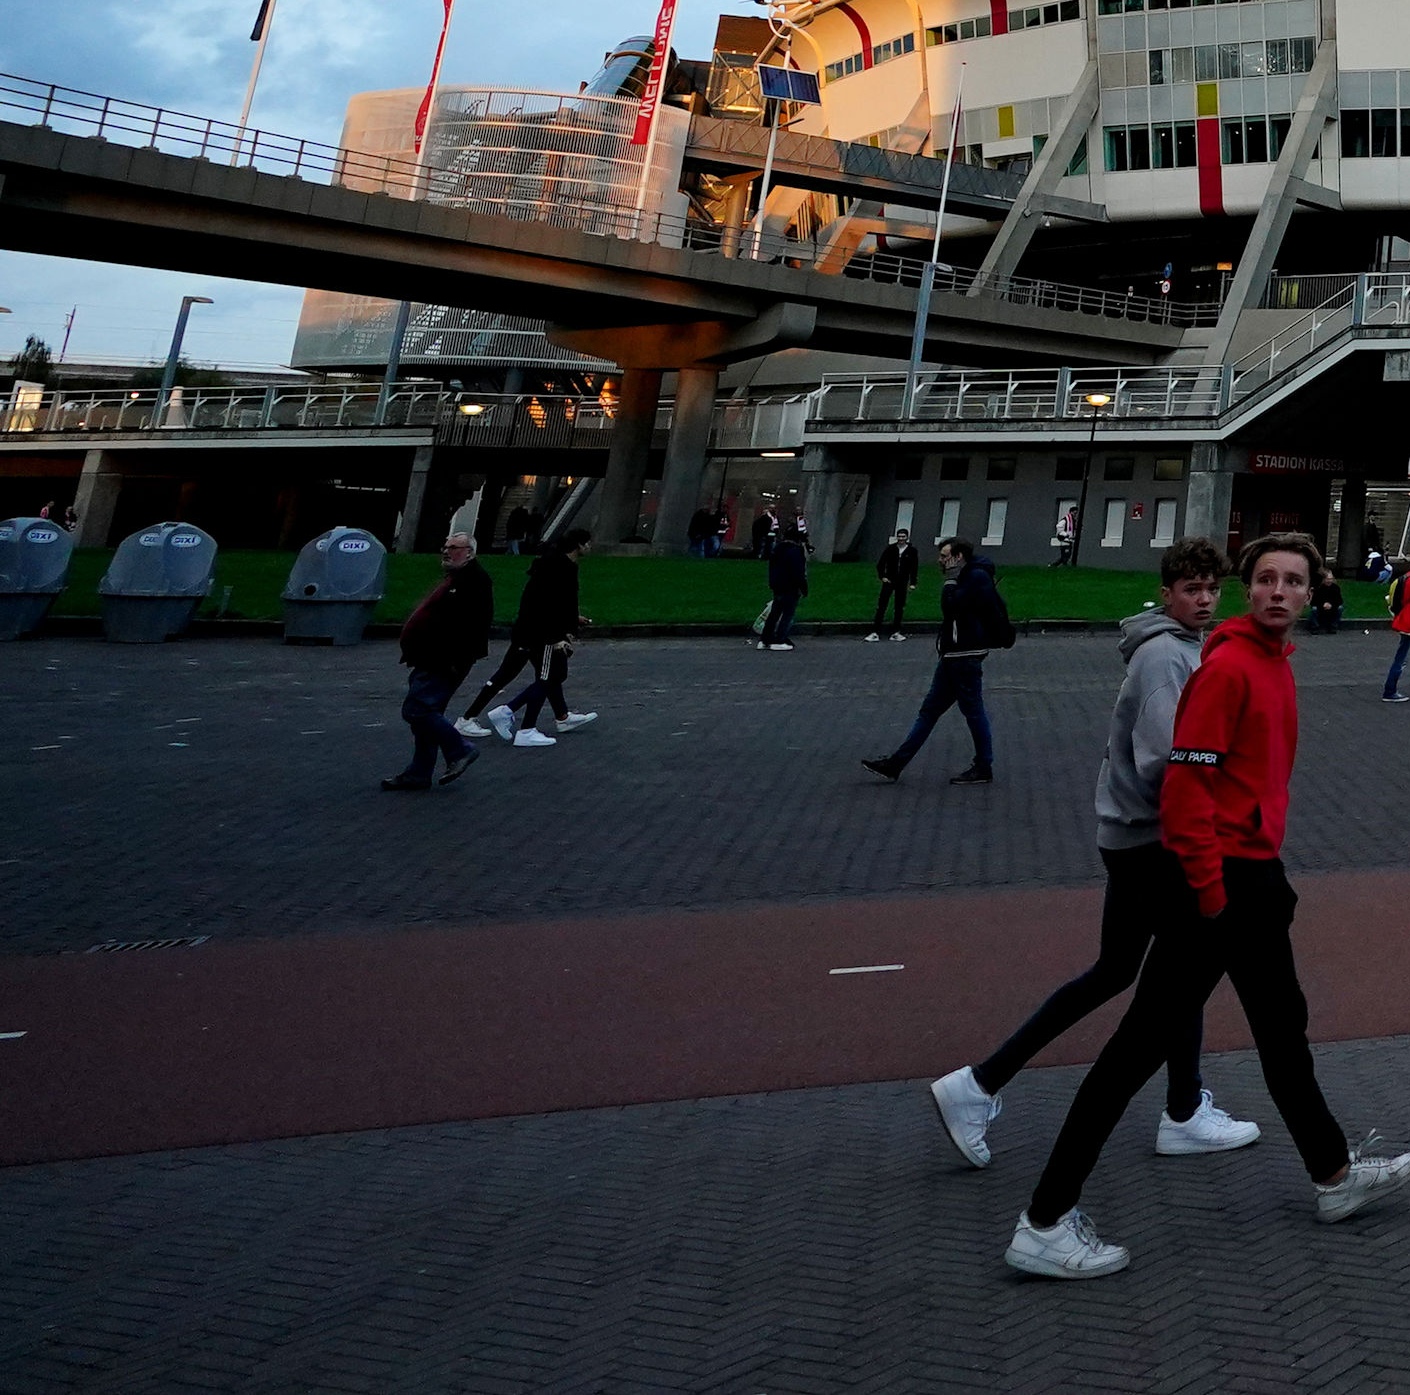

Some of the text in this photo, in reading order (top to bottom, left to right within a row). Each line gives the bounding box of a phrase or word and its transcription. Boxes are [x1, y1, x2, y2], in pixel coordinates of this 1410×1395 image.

[1256, 454, 1306, 470] STADION
[1309, 457, 1345, 472] KASSA
[1188, 751, 1217, 764] PAPER
